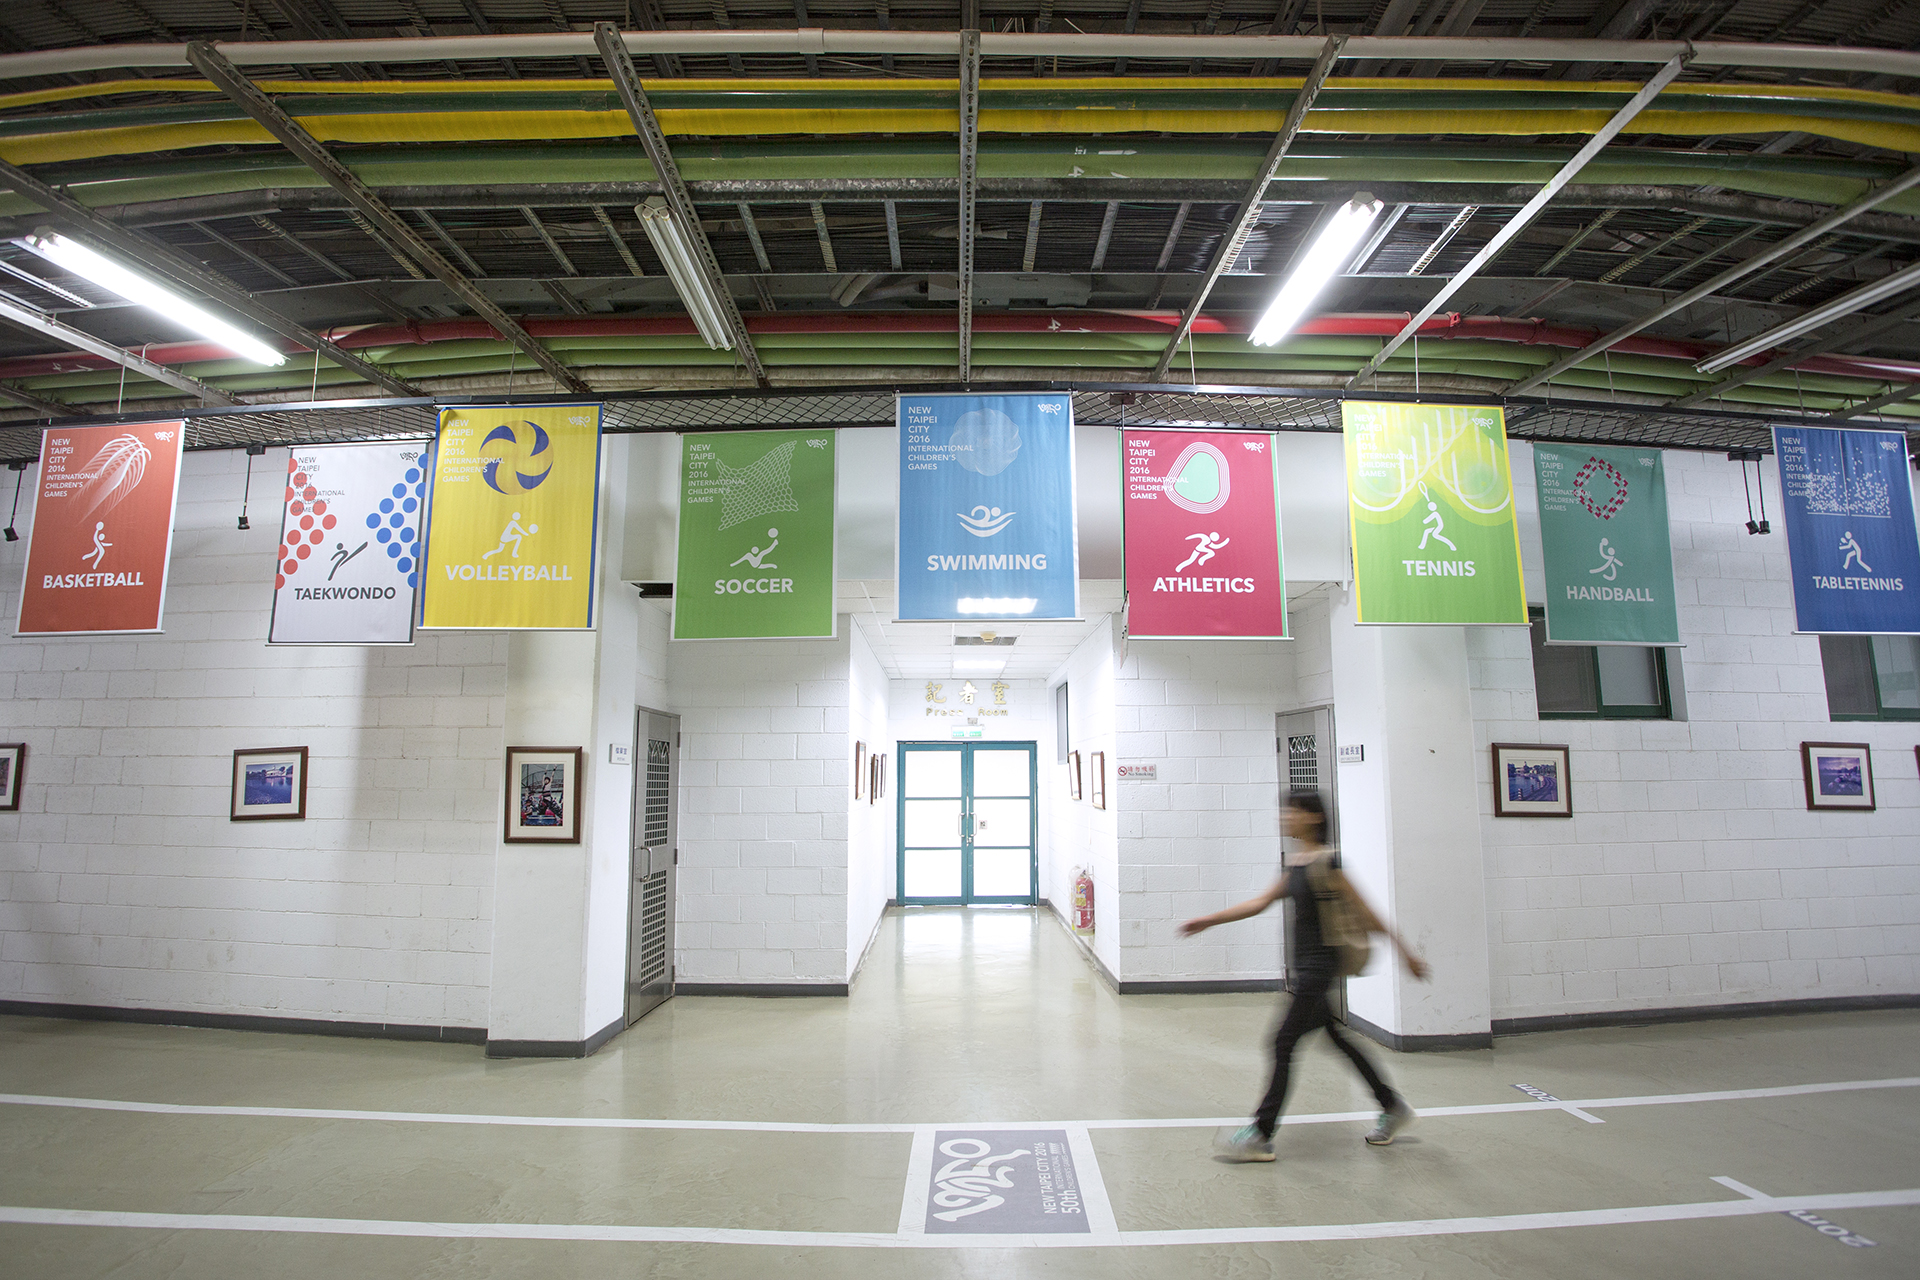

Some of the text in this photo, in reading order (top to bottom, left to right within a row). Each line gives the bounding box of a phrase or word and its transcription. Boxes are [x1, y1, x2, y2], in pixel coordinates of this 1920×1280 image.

[446, 438, 466, 446] CITY
[1544, 496, 1580, 504] CHILDREN'S
[927, 553, 1047, 572] SWIMMING
[1402, 560, 1476, 577] TENNIS
[42, 572, 144, 589] BASKETBALL
[445, 565, 572, 581] VOLLEYBALL
[714, 578, 793, 595] SOCCER
[1153, 577, 1255, 593] ATHLETICS
[1812, 576, 1903, 591] TABLETENNIS
[295, 587, 396, 600] TAEKWONDO
[1566, 586, 1654, 602] HANDBALL
[926, 680, 1010, 705] 記者室
[926, 708, 1008, 716] Press Room
[1034, 1142, 1057, 1214] NEW TAIPEI CITY 2016
[1057, 1190, 1081, 1214] 50th
[1789, 1210, 1878, 1248] 20m
